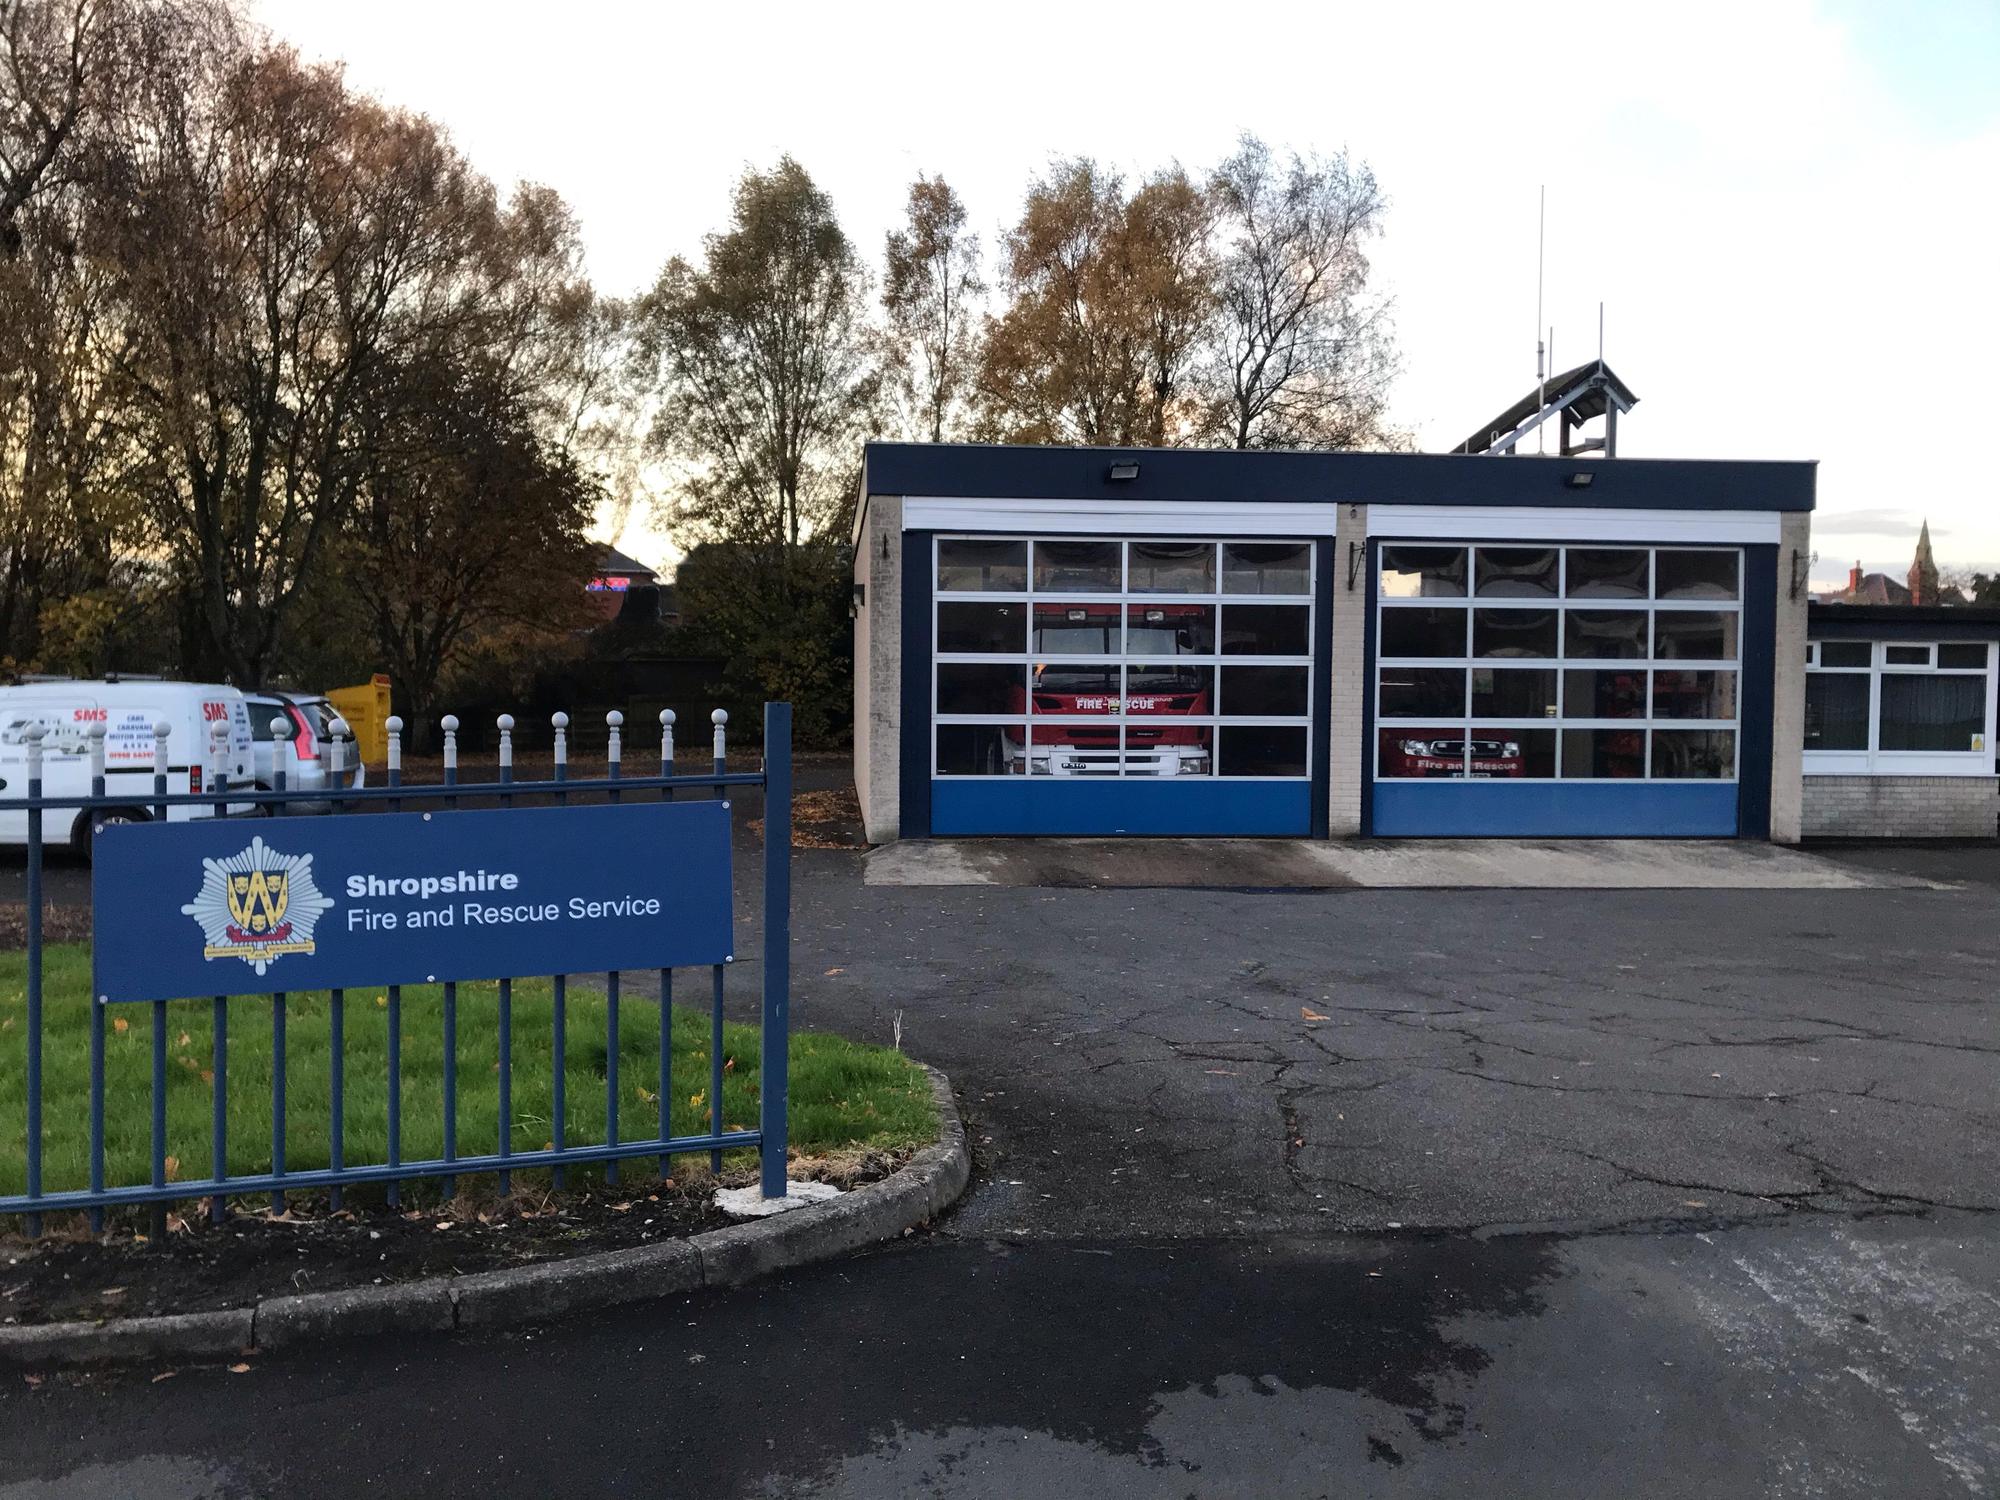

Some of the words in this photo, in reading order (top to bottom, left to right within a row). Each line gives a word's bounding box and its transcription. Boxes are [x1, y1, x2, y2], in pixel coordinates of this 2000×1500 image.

[73, 709, 107, 721] SMS
[203, 703, 228, 721] SMS
[1417, 760, 1443, 769] Fire
[1474, 762, 1518, 770] Rescue
[346, 870, 518, 900] Shropshire
[347, 908, 398, 932] Fire
[406, 904, 454, 928] and
[464, 903, 560, 925] Rescue
[568, 894, 661, 919] Service
